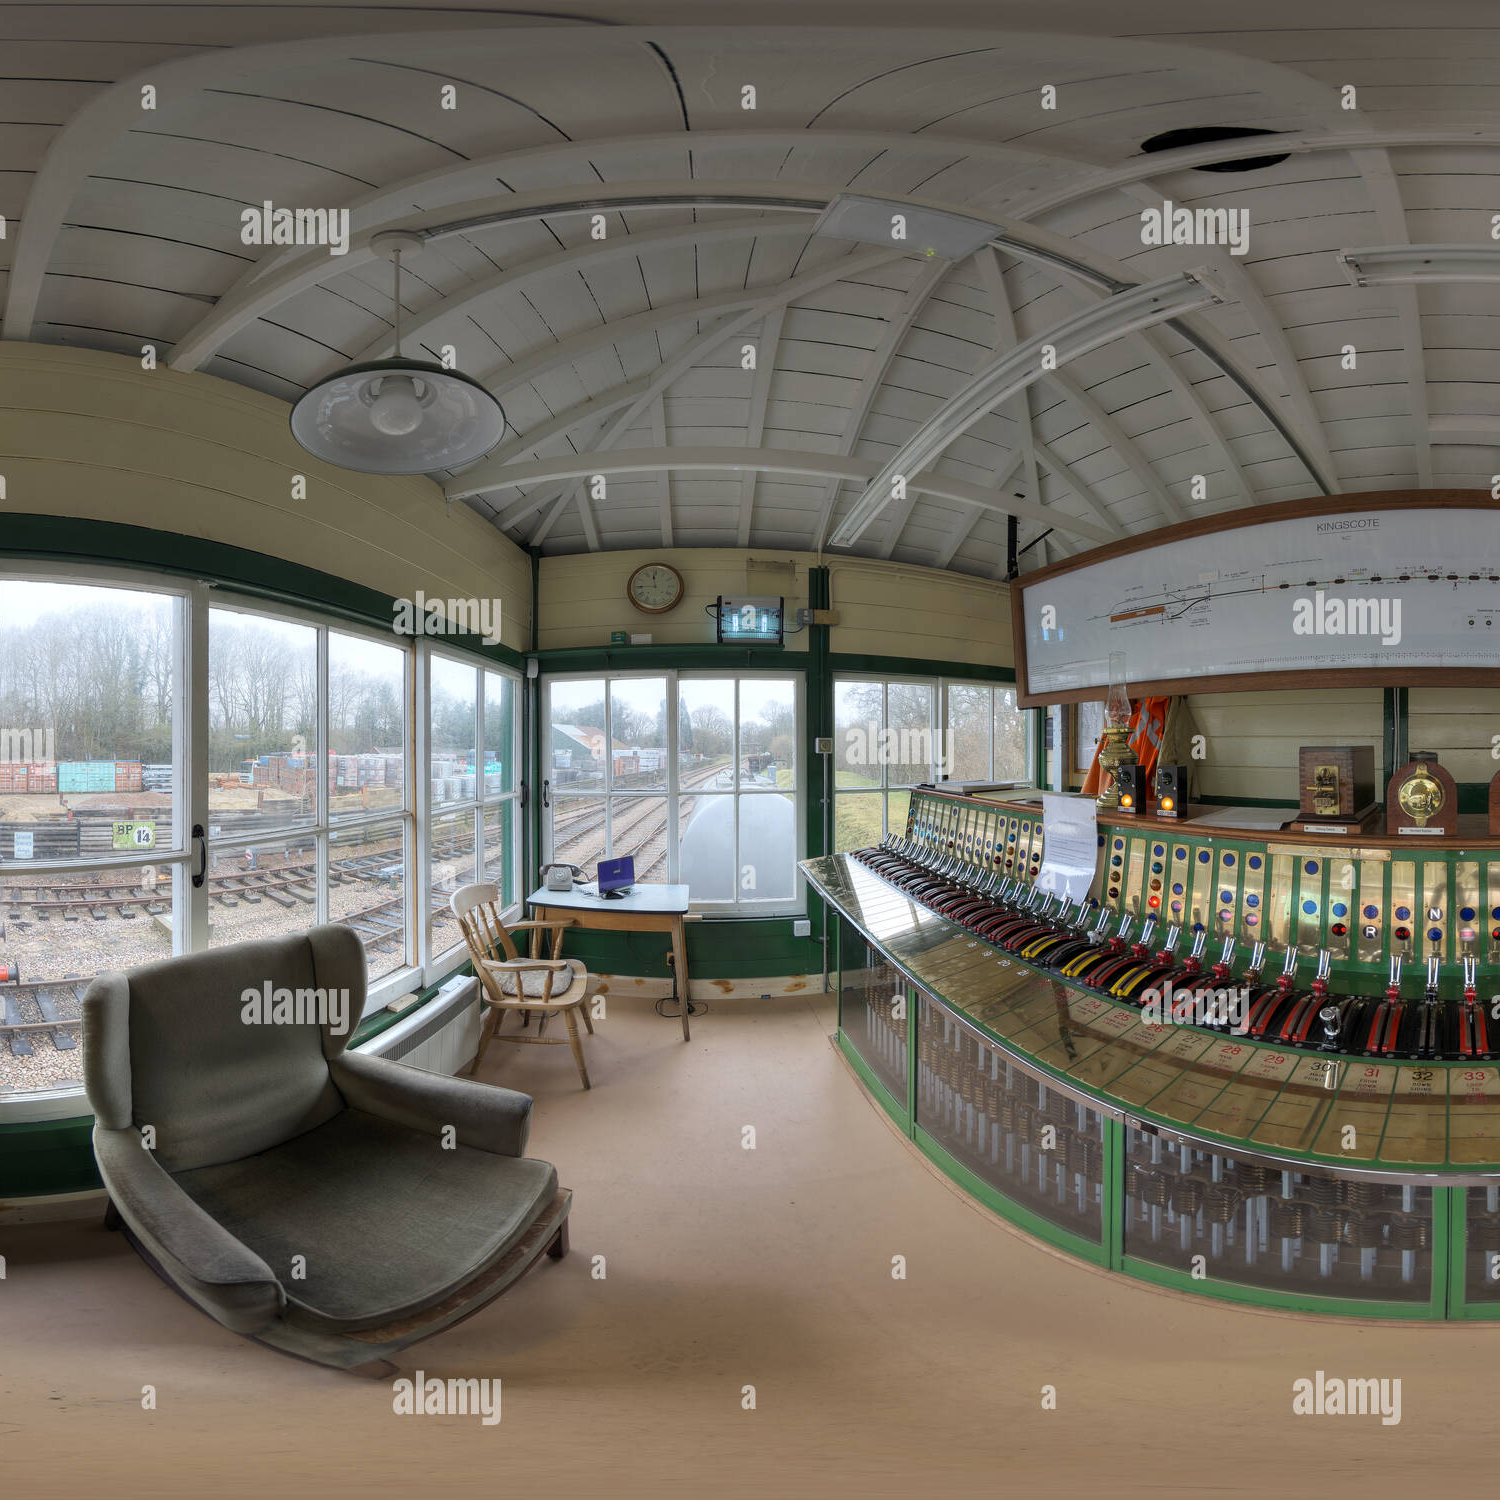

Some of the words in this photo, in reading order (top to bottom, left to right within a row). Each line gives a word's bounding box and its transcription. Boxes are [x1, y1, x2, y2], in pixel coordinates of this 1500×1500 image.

[1317, 519, 1380, 532] KINGSCOTE
[1430, 909, 1440, 918] N
[1366, 927, 1375, 937] R
[1114, 1012, 1132, 1022] 25
[1145, 1023, 1164, 1033] 26
[1220, 1045, 1242, 1056] 28
[1263, 1054, 1285, 1065] 29
[1310, 1062, 1331, 1072] 30
[1364, 1067, 1380, 1078] 31
[1412, 1071, 1433, 1081] 32
[1464, 1071, 1485, 1081] 33
